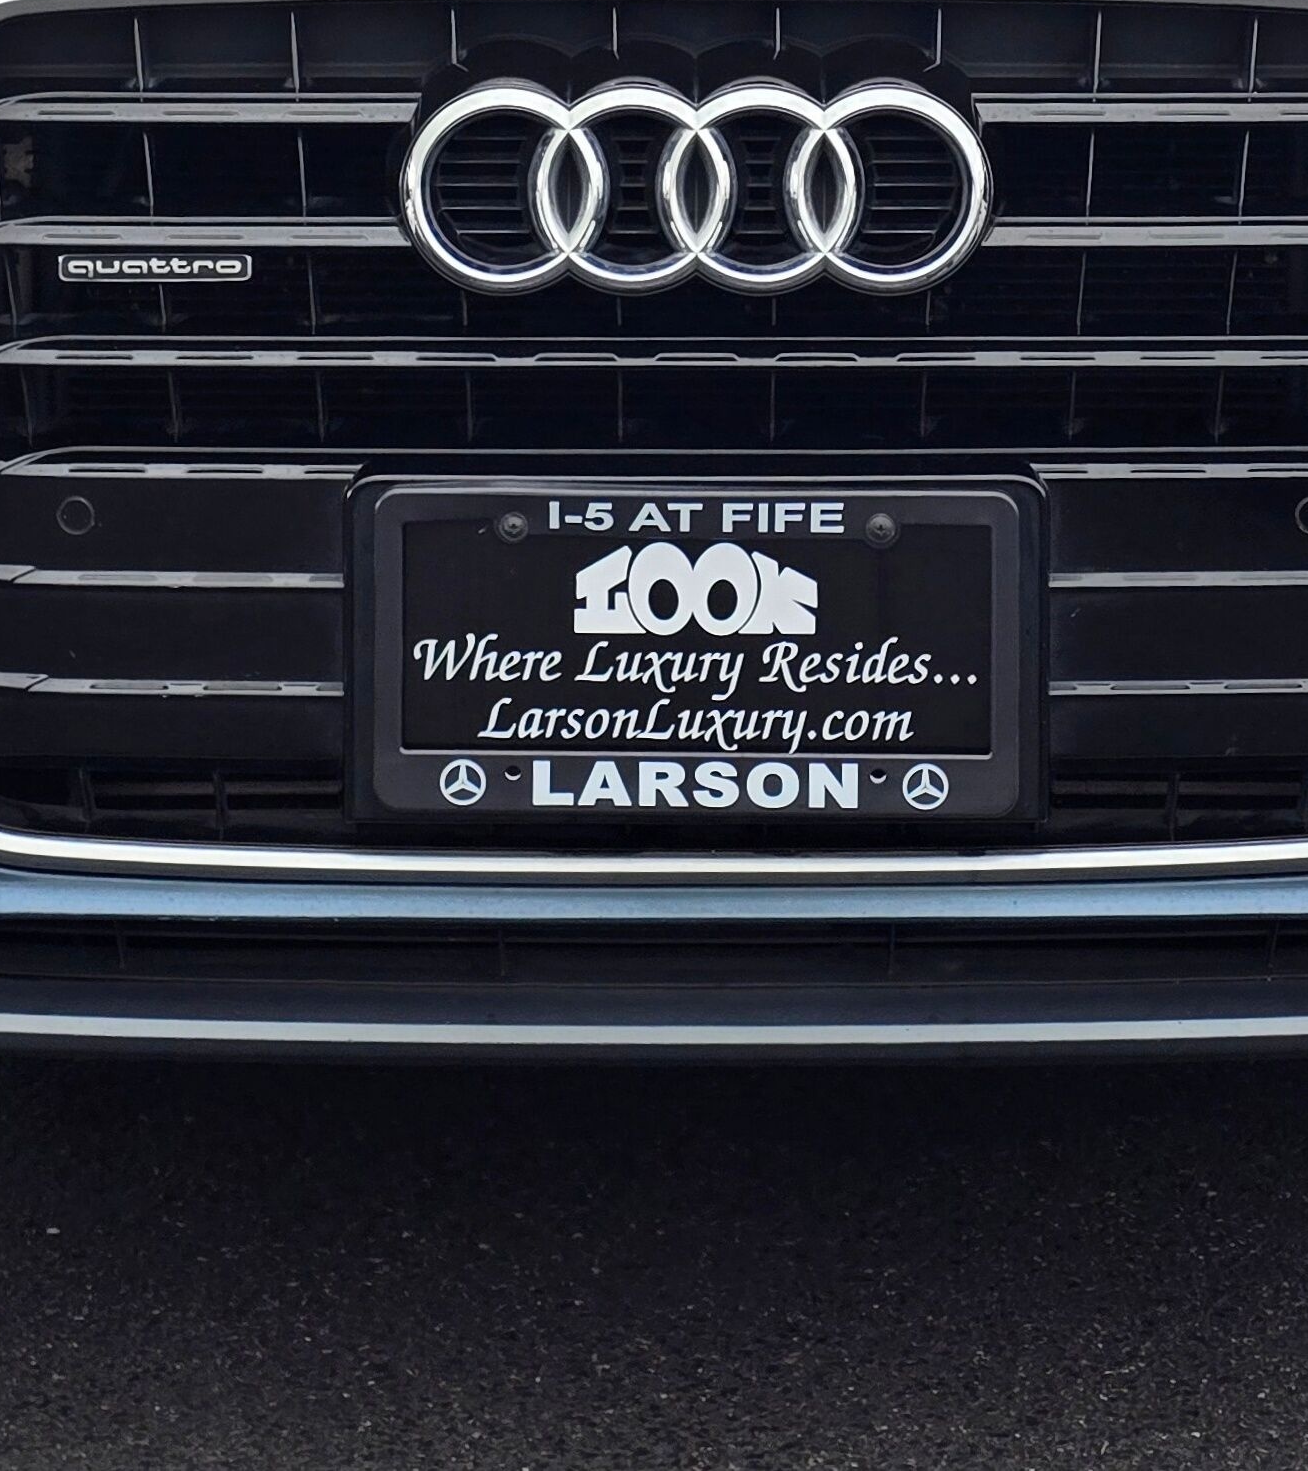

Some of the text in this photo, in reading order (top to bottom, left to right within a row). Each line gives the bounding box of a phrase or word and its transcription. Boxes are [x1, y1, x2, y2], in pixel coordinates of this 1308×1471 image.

[67, 257, 242, 278] quattro
[548, 500, 845, 534] I-5 AT FIFE
[573, 541, 819, 637] LOOK
[412, 632, 978, 701] Where Luxury Resides...
[477, 697, 915, 754] LarsonLuxury.com
[531, 759, 859, 809] LARSON
